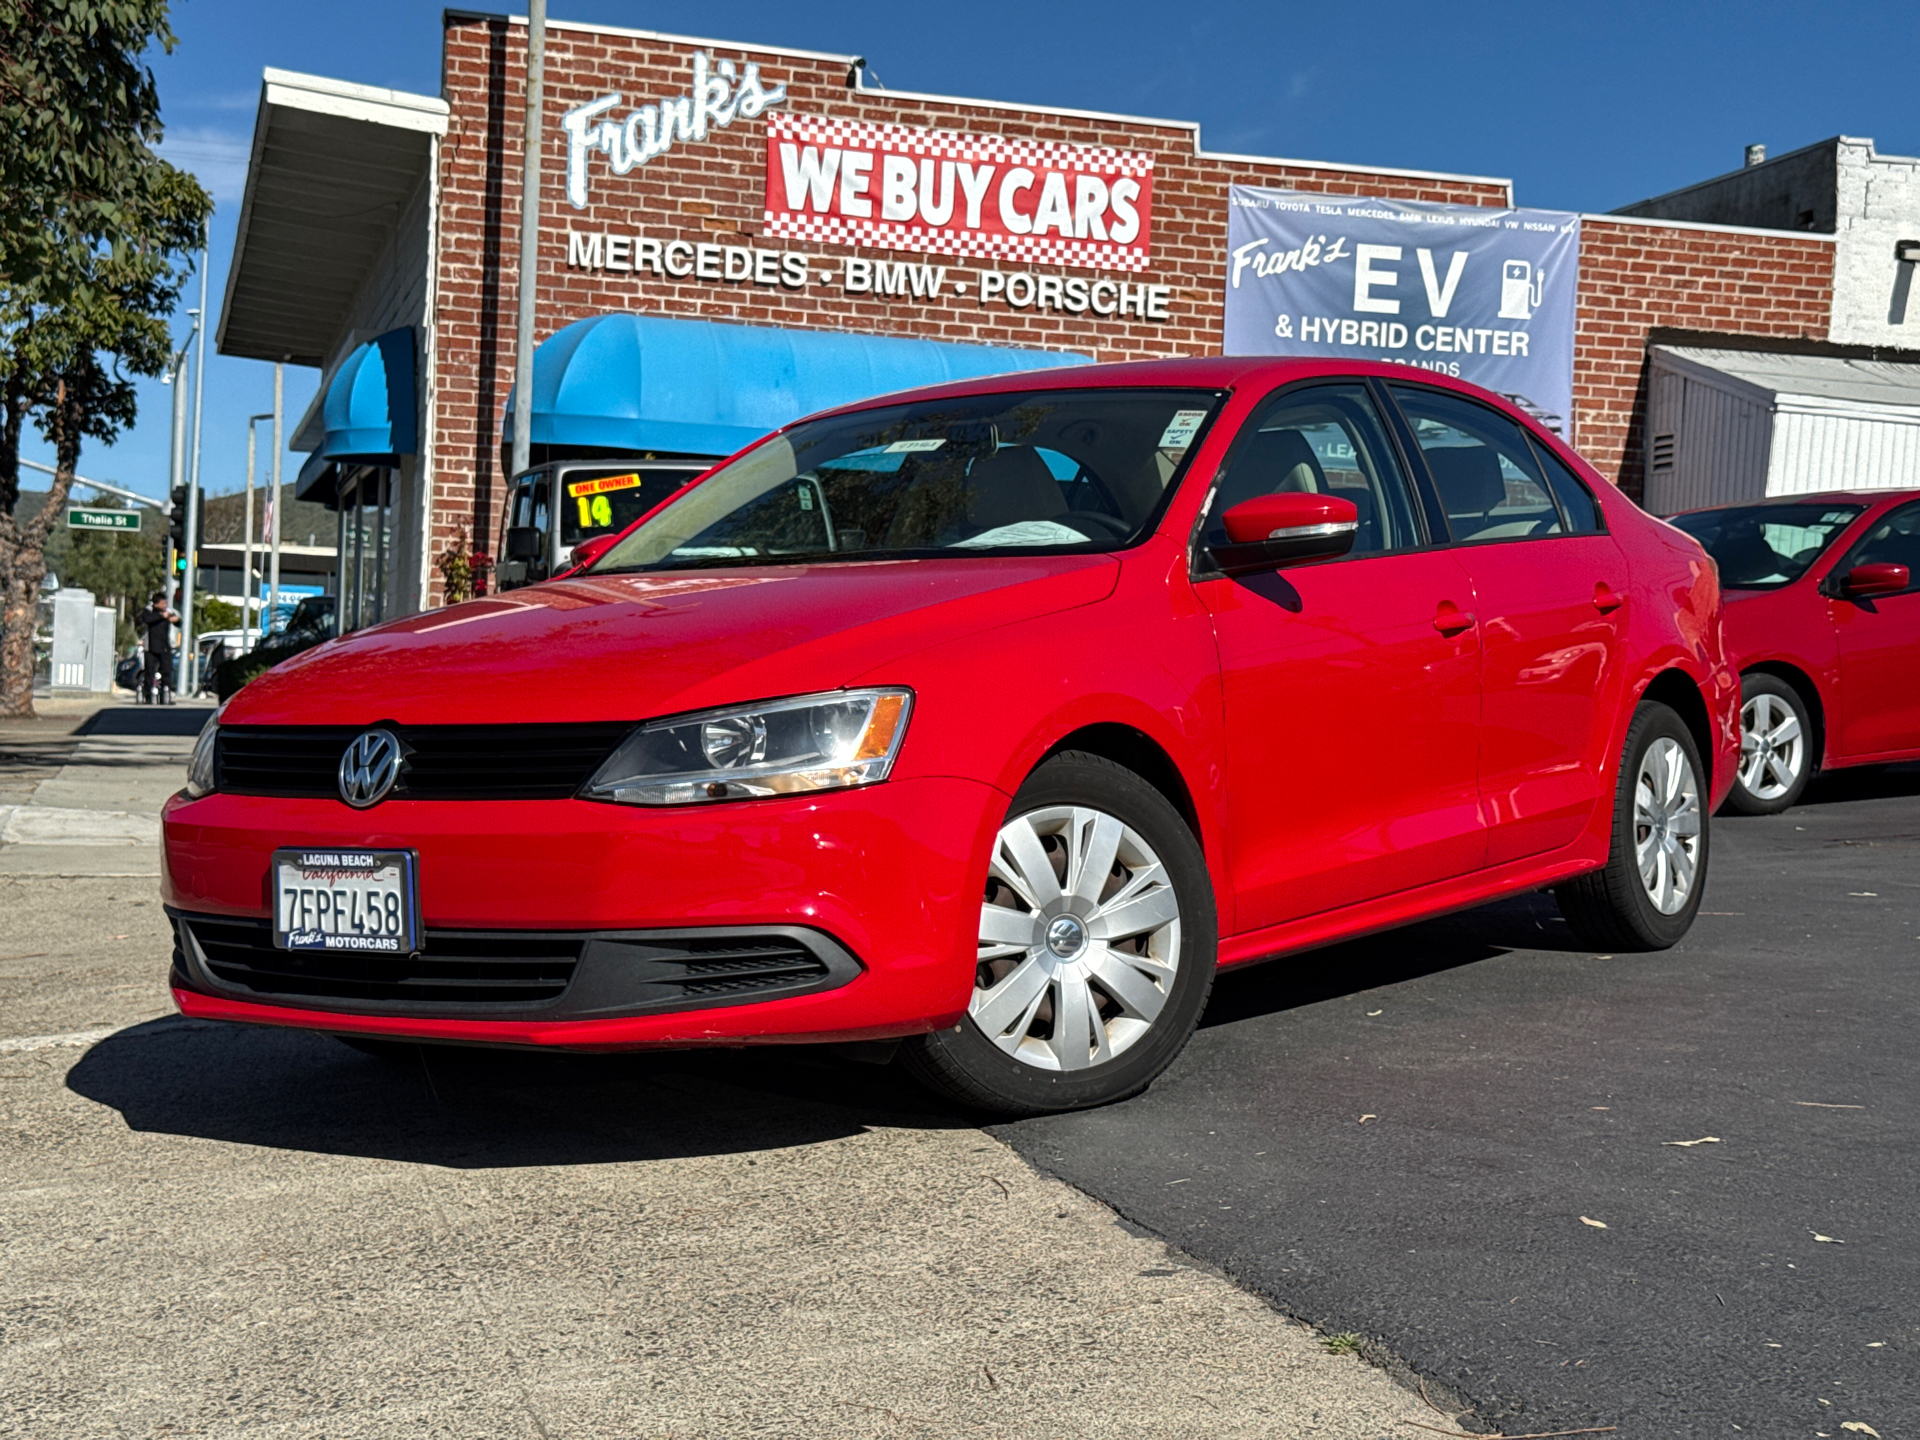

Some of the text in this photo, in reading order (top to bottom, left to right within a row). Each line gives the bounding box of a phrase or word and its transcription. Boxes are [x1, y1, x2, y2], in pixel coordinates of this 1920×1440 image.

[562, 50, 787, 209] Frank's
[779, 143, 1140, 244] WE BUY CARS
[1275, 201, 1310, 213] TOYOTA
[1315, 204, 1342, 216] TESLA
[1347, 207, 1396, 220] MERCEDES
[1426, 214, 1455, 225] LEXUS
[1459, 217, 1500, 228] HYUNDAI
[1504, 221, 1519, 230] VW
[1523, 223, 1556, 233] NISSAN
[568, 231, 1171, 319] MERCEDES BMW PORSCHE
[1232, 234, 1351, 289] Frank's
[1353, 243, 1469, 318] EV
[1275, 314, 1530, 357] & HYBRID CENTER
[575, 476, 634, 495] ONE OWNER
[81, 513, 127, 526] Thalia St
[577, 495, 612, 527] 14
[302, 868, 385, 888] California
[303, 854, 374, 867] LAGUNA BEACH
[284, 888, 401, 936] 7FPF458
[325, 936, 399, 950] MOTORCARS
